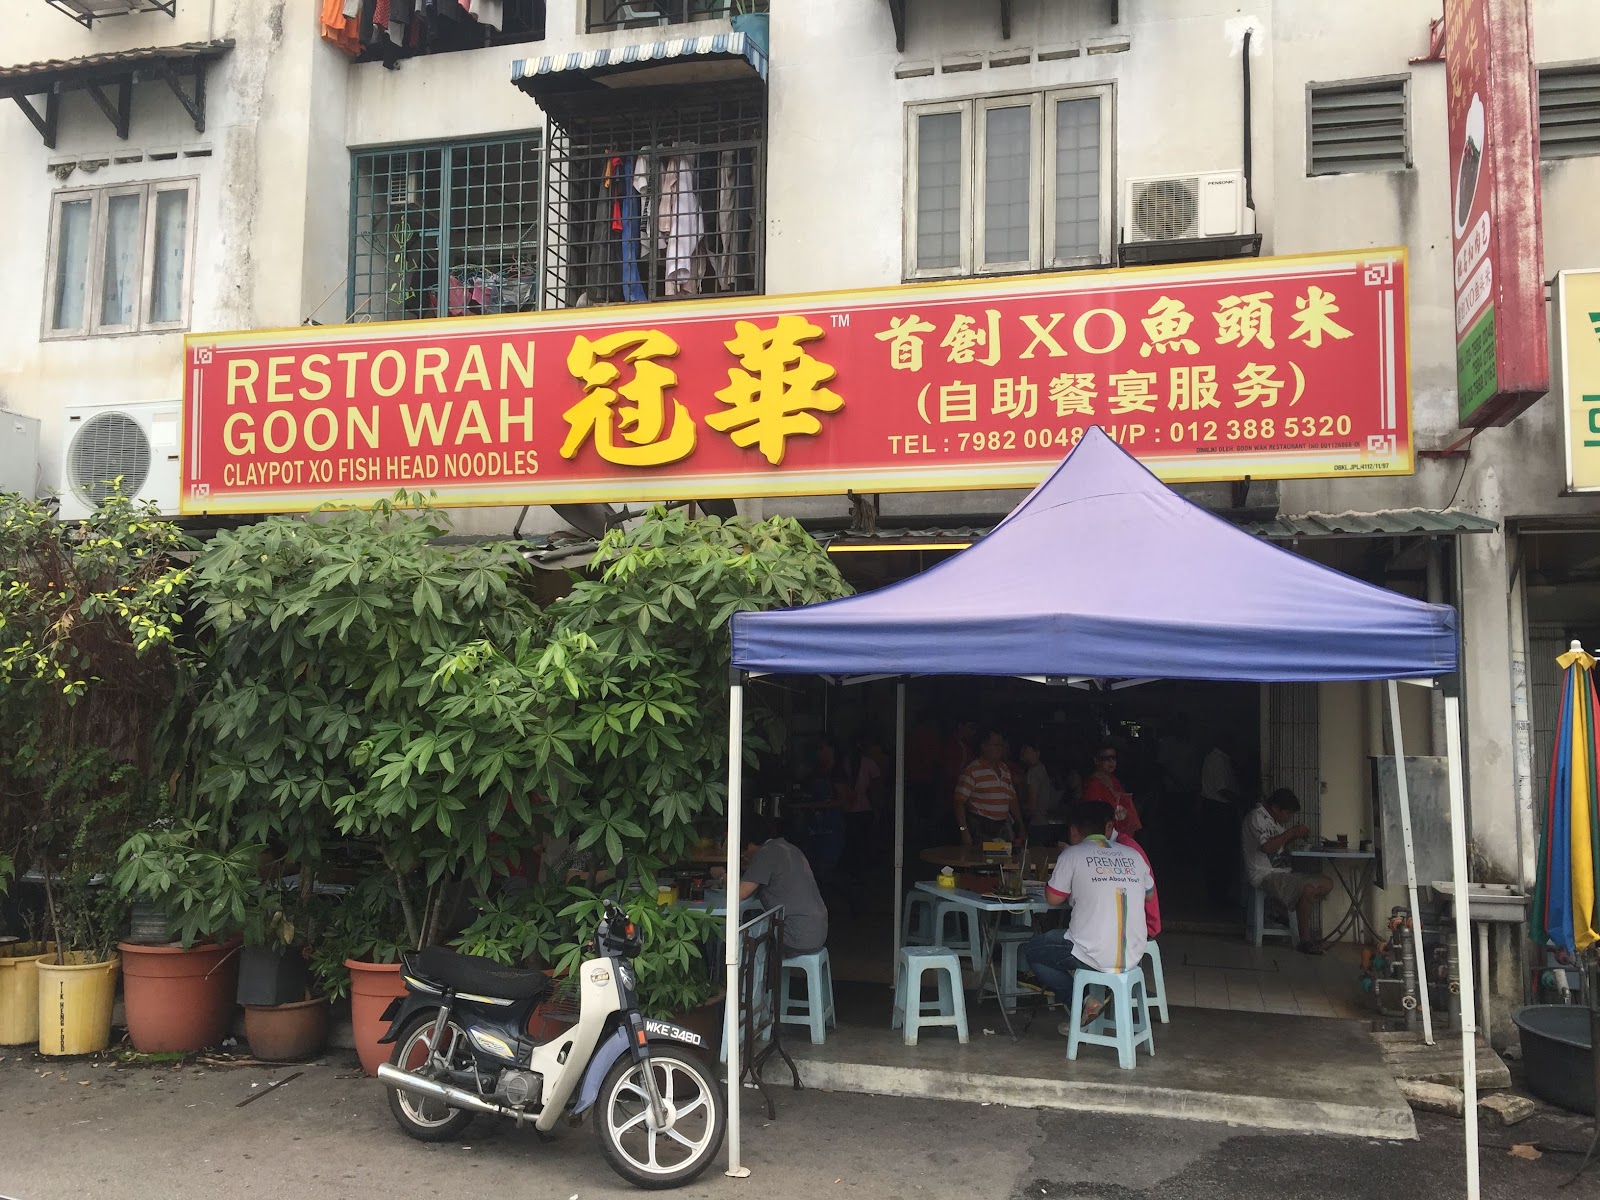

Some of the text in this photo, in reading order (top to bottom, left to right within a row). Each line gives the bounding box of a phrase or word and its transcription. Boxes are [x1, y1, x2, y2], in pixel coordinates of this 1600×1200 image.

[830, 313, 850, 328] TM
[226, 340, 536, 406] RESTORAN
[559, 315, 846, 467] 冠華
[222, 397, 534, 456] GOON WAH
[957, 430, 1016, 452] 7982
[1023, 426, 1084, 449] 0048
[1169, 420, 1218, 443] 012
[1225, 417, 1276, 441] 388
[1284, 413, 1353, 438] 5320
[1268, 443, 1306, 451] RESTAURANT
[223, 449, 539, 487] CLAYPOT XO FISH HEAD NOODLES
[1086, 856, 1136, 868] PREMIER
[1096, 867, 1136, 875] COLOURS
[645, 1020, 701, 1045] WKE 3480
